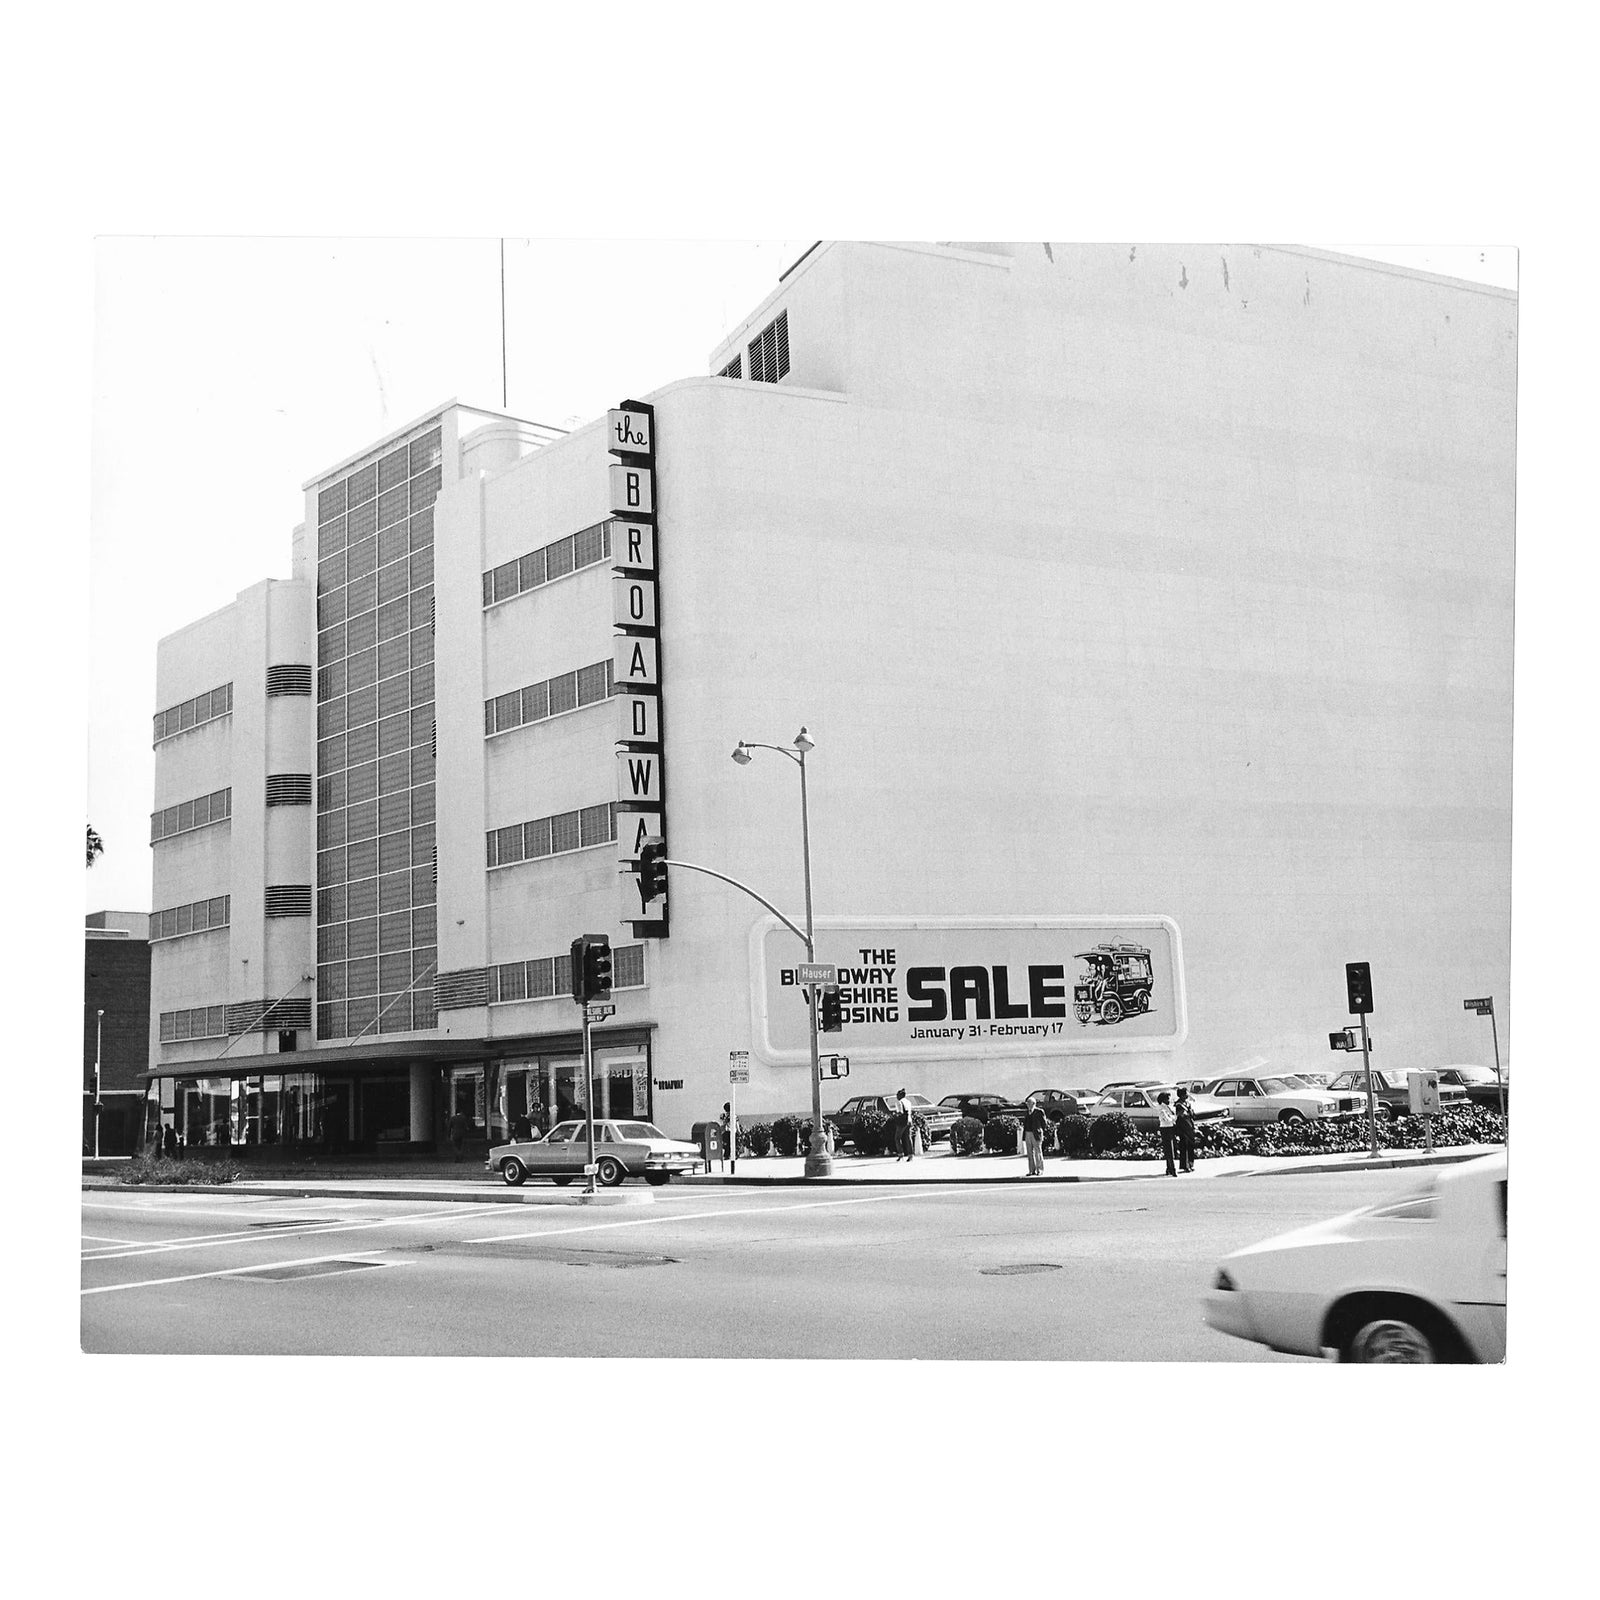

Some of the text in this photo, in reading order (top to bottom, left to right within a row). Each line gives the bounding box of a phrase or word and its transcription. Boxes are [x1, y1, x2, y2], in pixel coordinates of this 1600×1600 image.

[615, 415, 648, 445] the
[859, 949, 896, 964] THE
[781, 968, 896, 985] BDWAY
[802, 968, 831, 979] Hauser
[907, 965, 1066, 1021] SALE
[818, 1006, 899, 1023] OSING
[911, 1027, 964, 1040] January
[969, 1025, 981, 1036] 31
[990, 1022, 1048, 1037] February
[1051, 1023, 1064, 1034] 17
